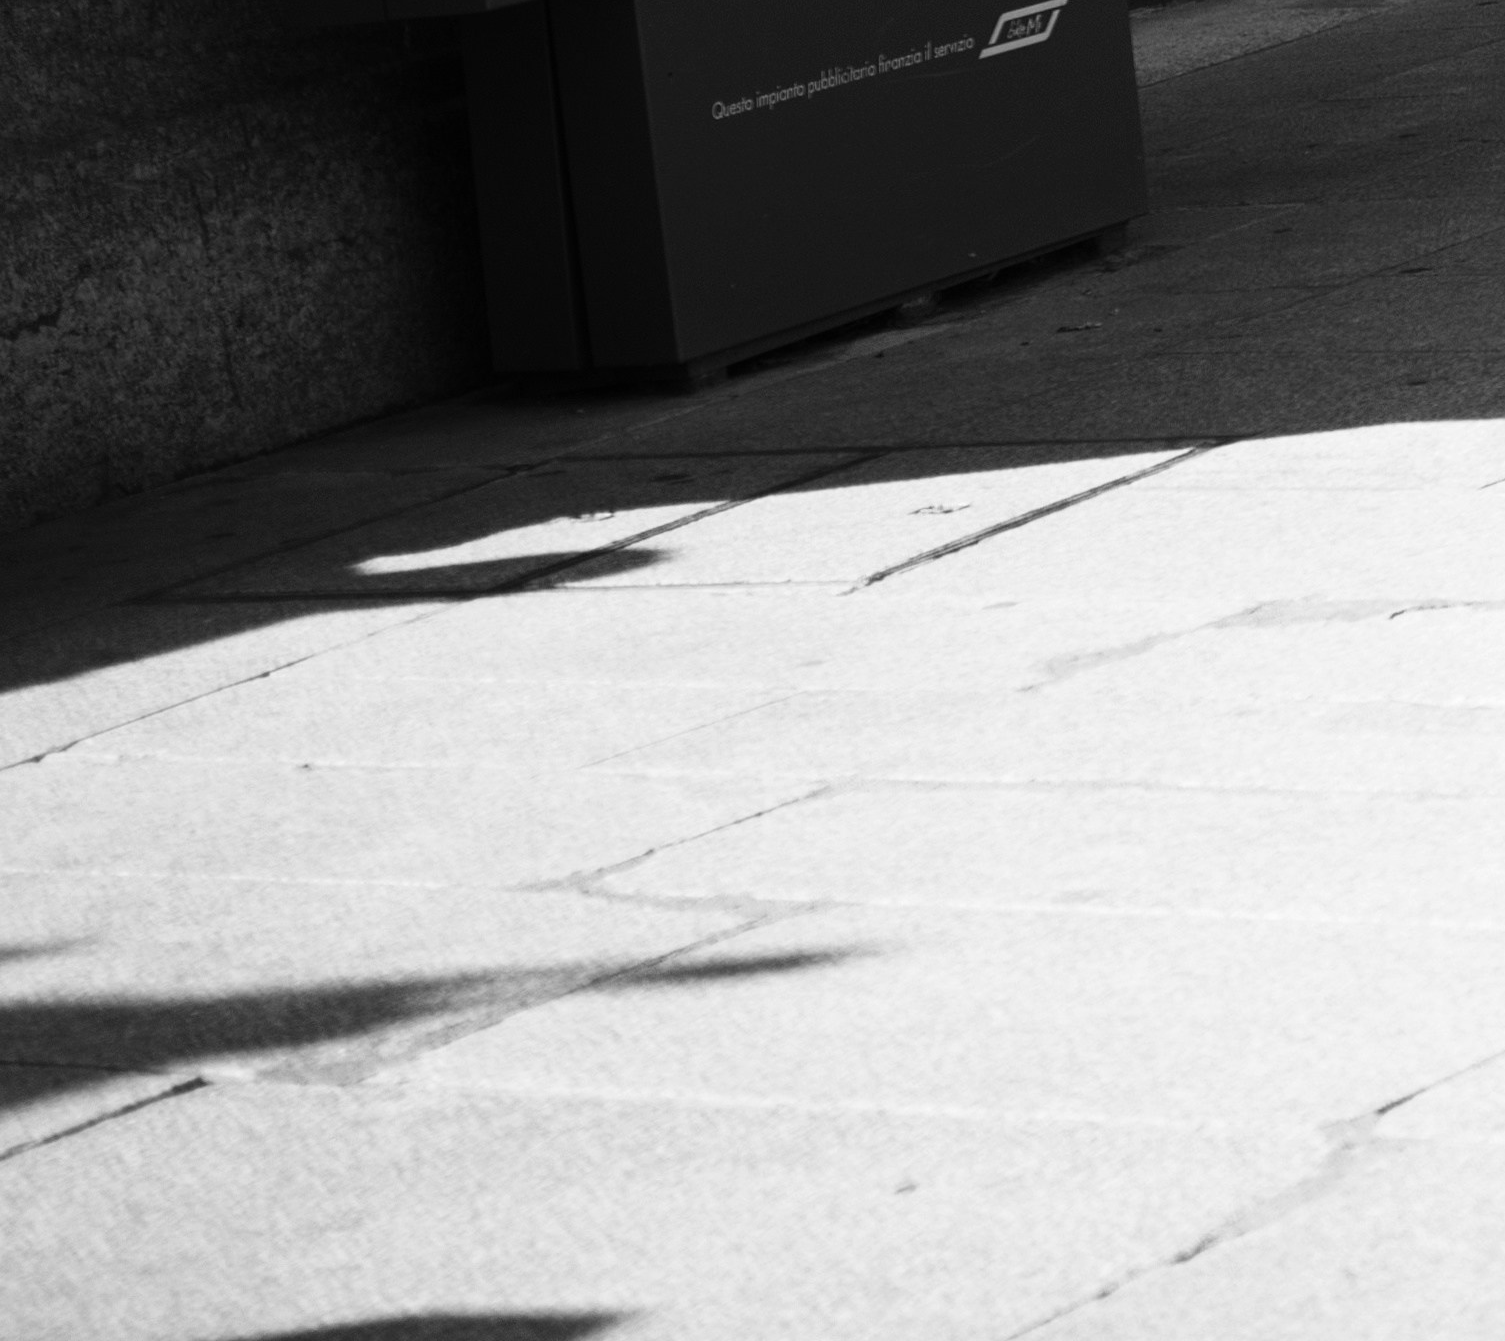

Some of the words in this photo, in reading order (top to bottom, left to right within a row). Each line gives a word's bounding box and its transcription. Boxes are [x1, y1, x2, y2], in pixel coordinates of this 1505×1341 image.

[712, 96, 754, 120] Questo
[755, 83, 805, 111] impianto
[807, 61, 877, 99] pubblicitario
[878, 48, 923, 74] finanzia
[924, 40, 933, 61] il
[933, 32, 975, 59] servizio
